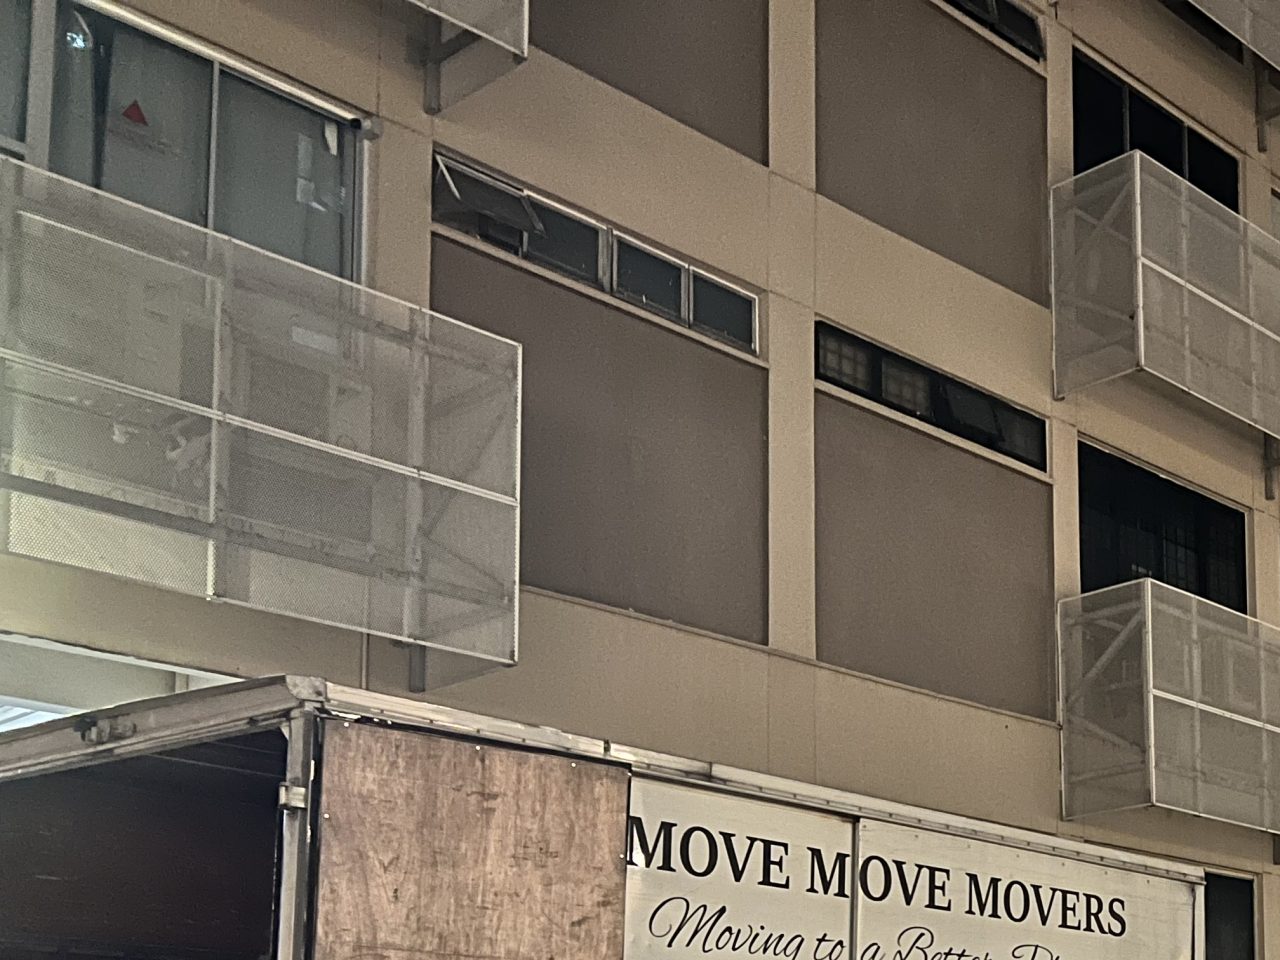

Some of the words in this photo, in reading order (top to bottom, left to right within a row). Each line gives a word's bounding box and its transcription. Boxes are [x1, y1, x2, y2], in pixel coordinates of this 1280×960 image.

[627, 815, 790, 889] MOVE
[806, 846, 951, 912] MOVE
[965, 872, 1127, 937] MOVERS
